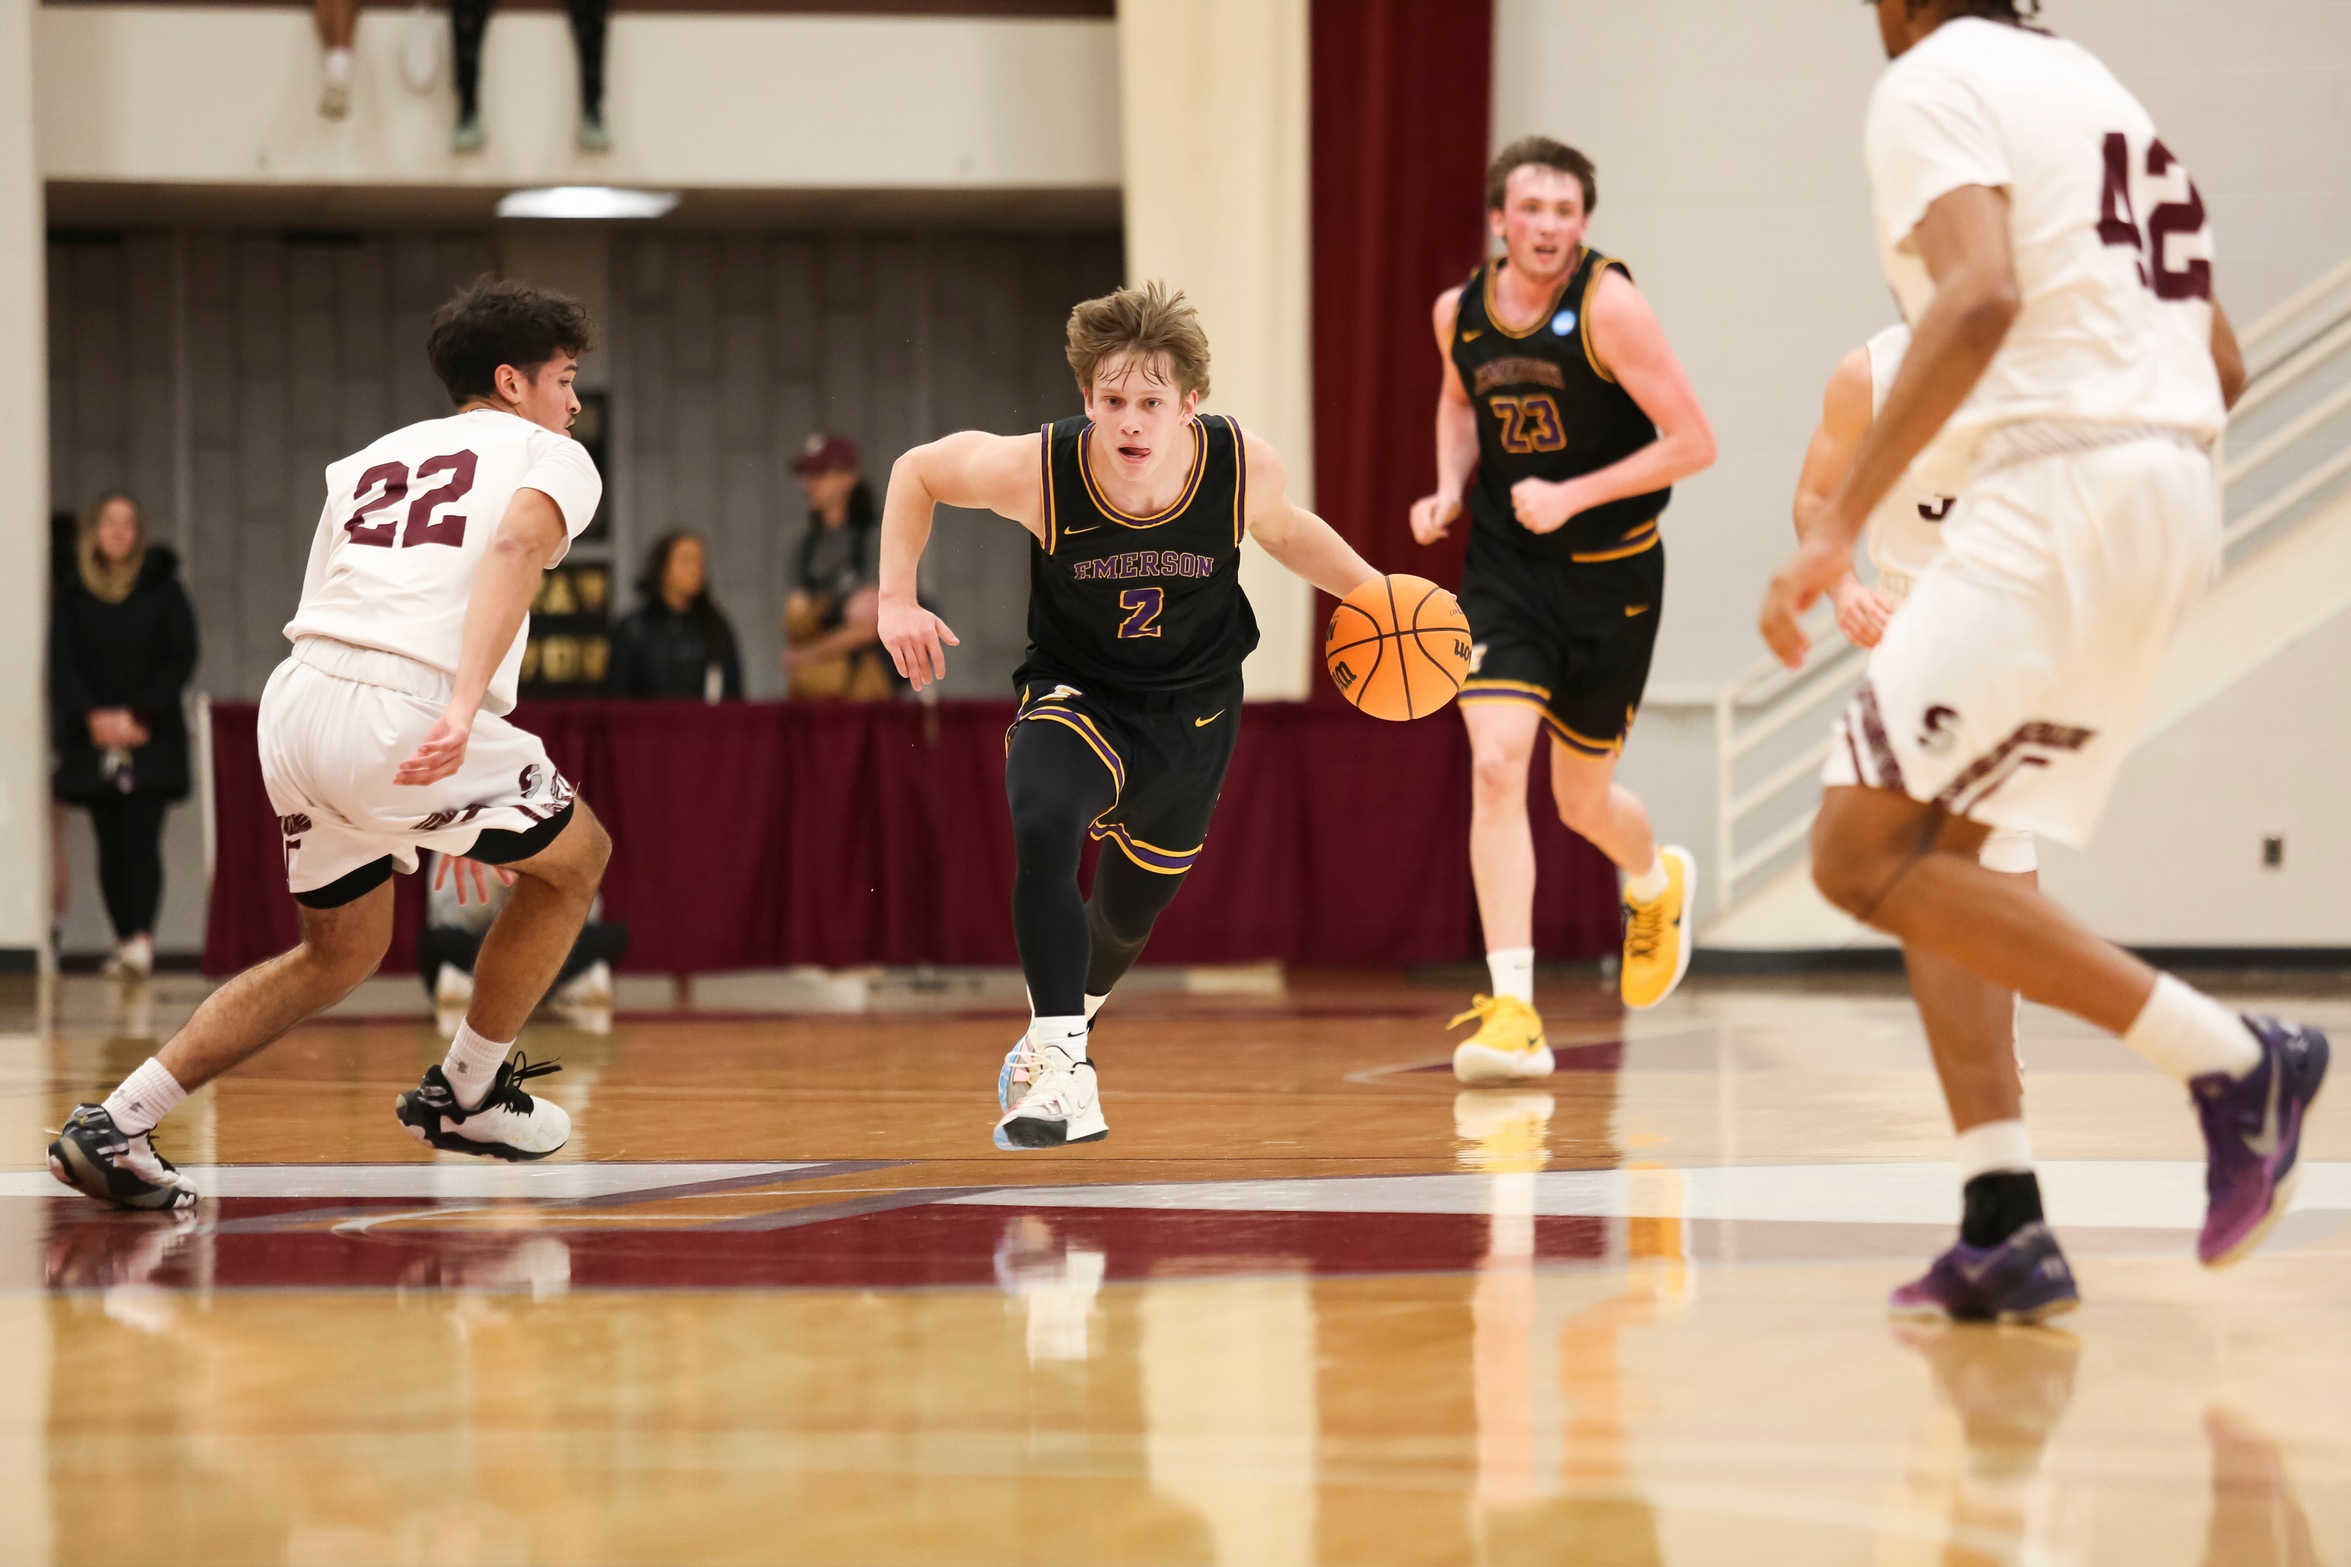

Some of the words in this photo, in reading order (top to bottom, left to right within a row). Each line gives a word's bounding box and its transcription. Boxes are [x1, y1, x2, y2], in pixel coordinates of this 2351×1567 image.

[2096, 132, 2212, 301] 42
[1489, 393, 1568, 454] 23
[343, 448, 479, 549] 22
[1073, 550, 1215, 580] EMERSON
[1117, 586, 1165, 639] 2
